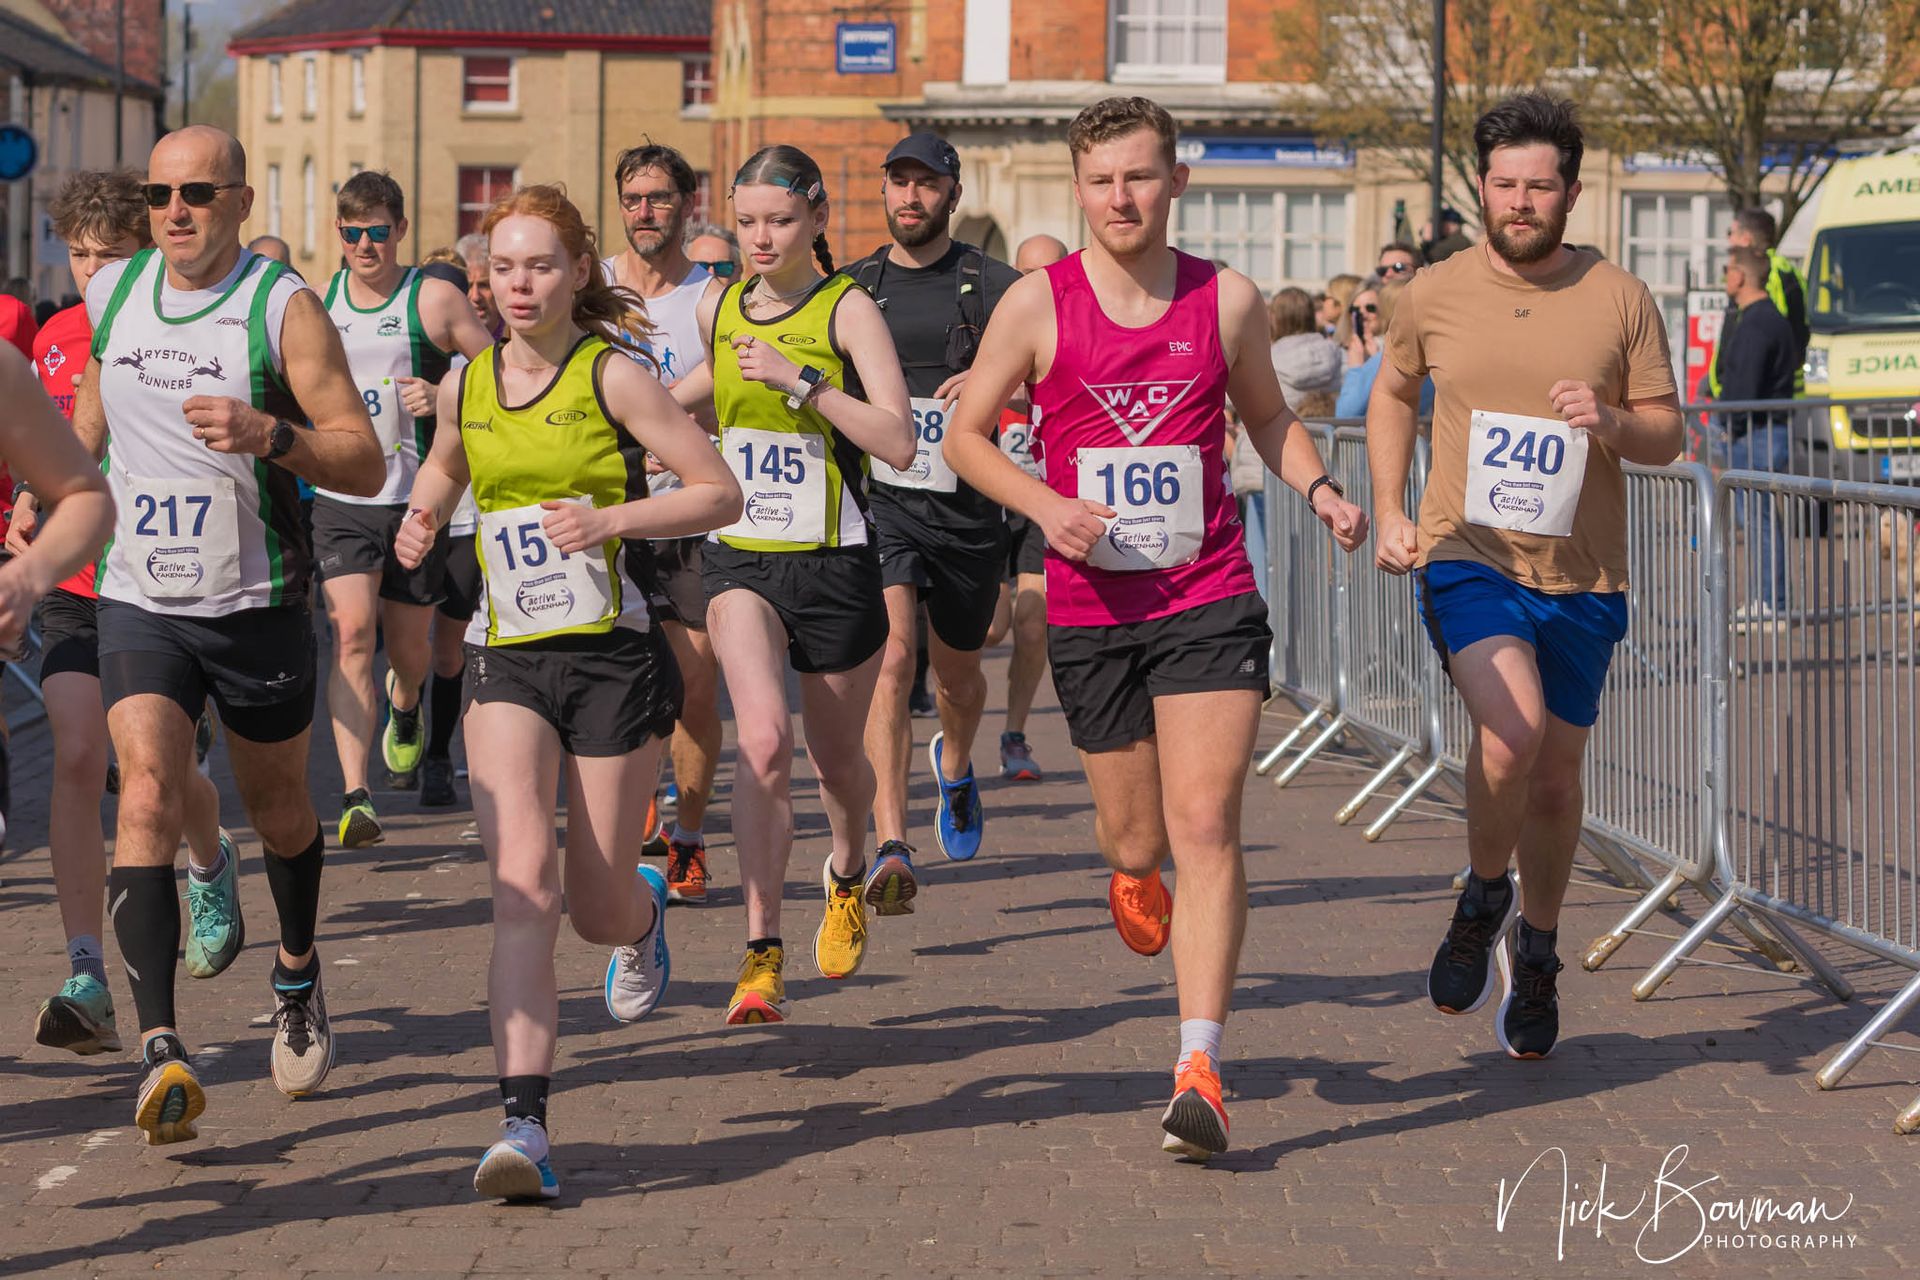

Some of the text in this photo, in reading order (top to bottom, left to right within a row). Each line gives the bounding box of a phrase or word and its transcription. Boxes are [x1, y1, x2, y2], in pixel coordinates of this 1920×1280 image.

[1168, 341, 1193, 353] EPIC
[144, 349, 198, 366] RYSTON
[137, 372, 193, 390] RUNNERS
[1483, 426, 1565, 475] 240
[738, 442, 806, 485] 145
[1096, 461, 1180, 506] 166
[1500, 495, 1528, 506] active
[756, 506, 779, 516] active
[1497, 503, 1538, 513] FAKENHAM
[135, 494, 212, 536] 217
[1121, 532, 1151, 543] active
[495, 522, 570, 571] 15
[1119, 542, 1163, 550] FAKENHAM
[158, 562, 186, 572] active
[528, 592, 556, 606] active
[527, 600, 569, 612] FAKENHAM
